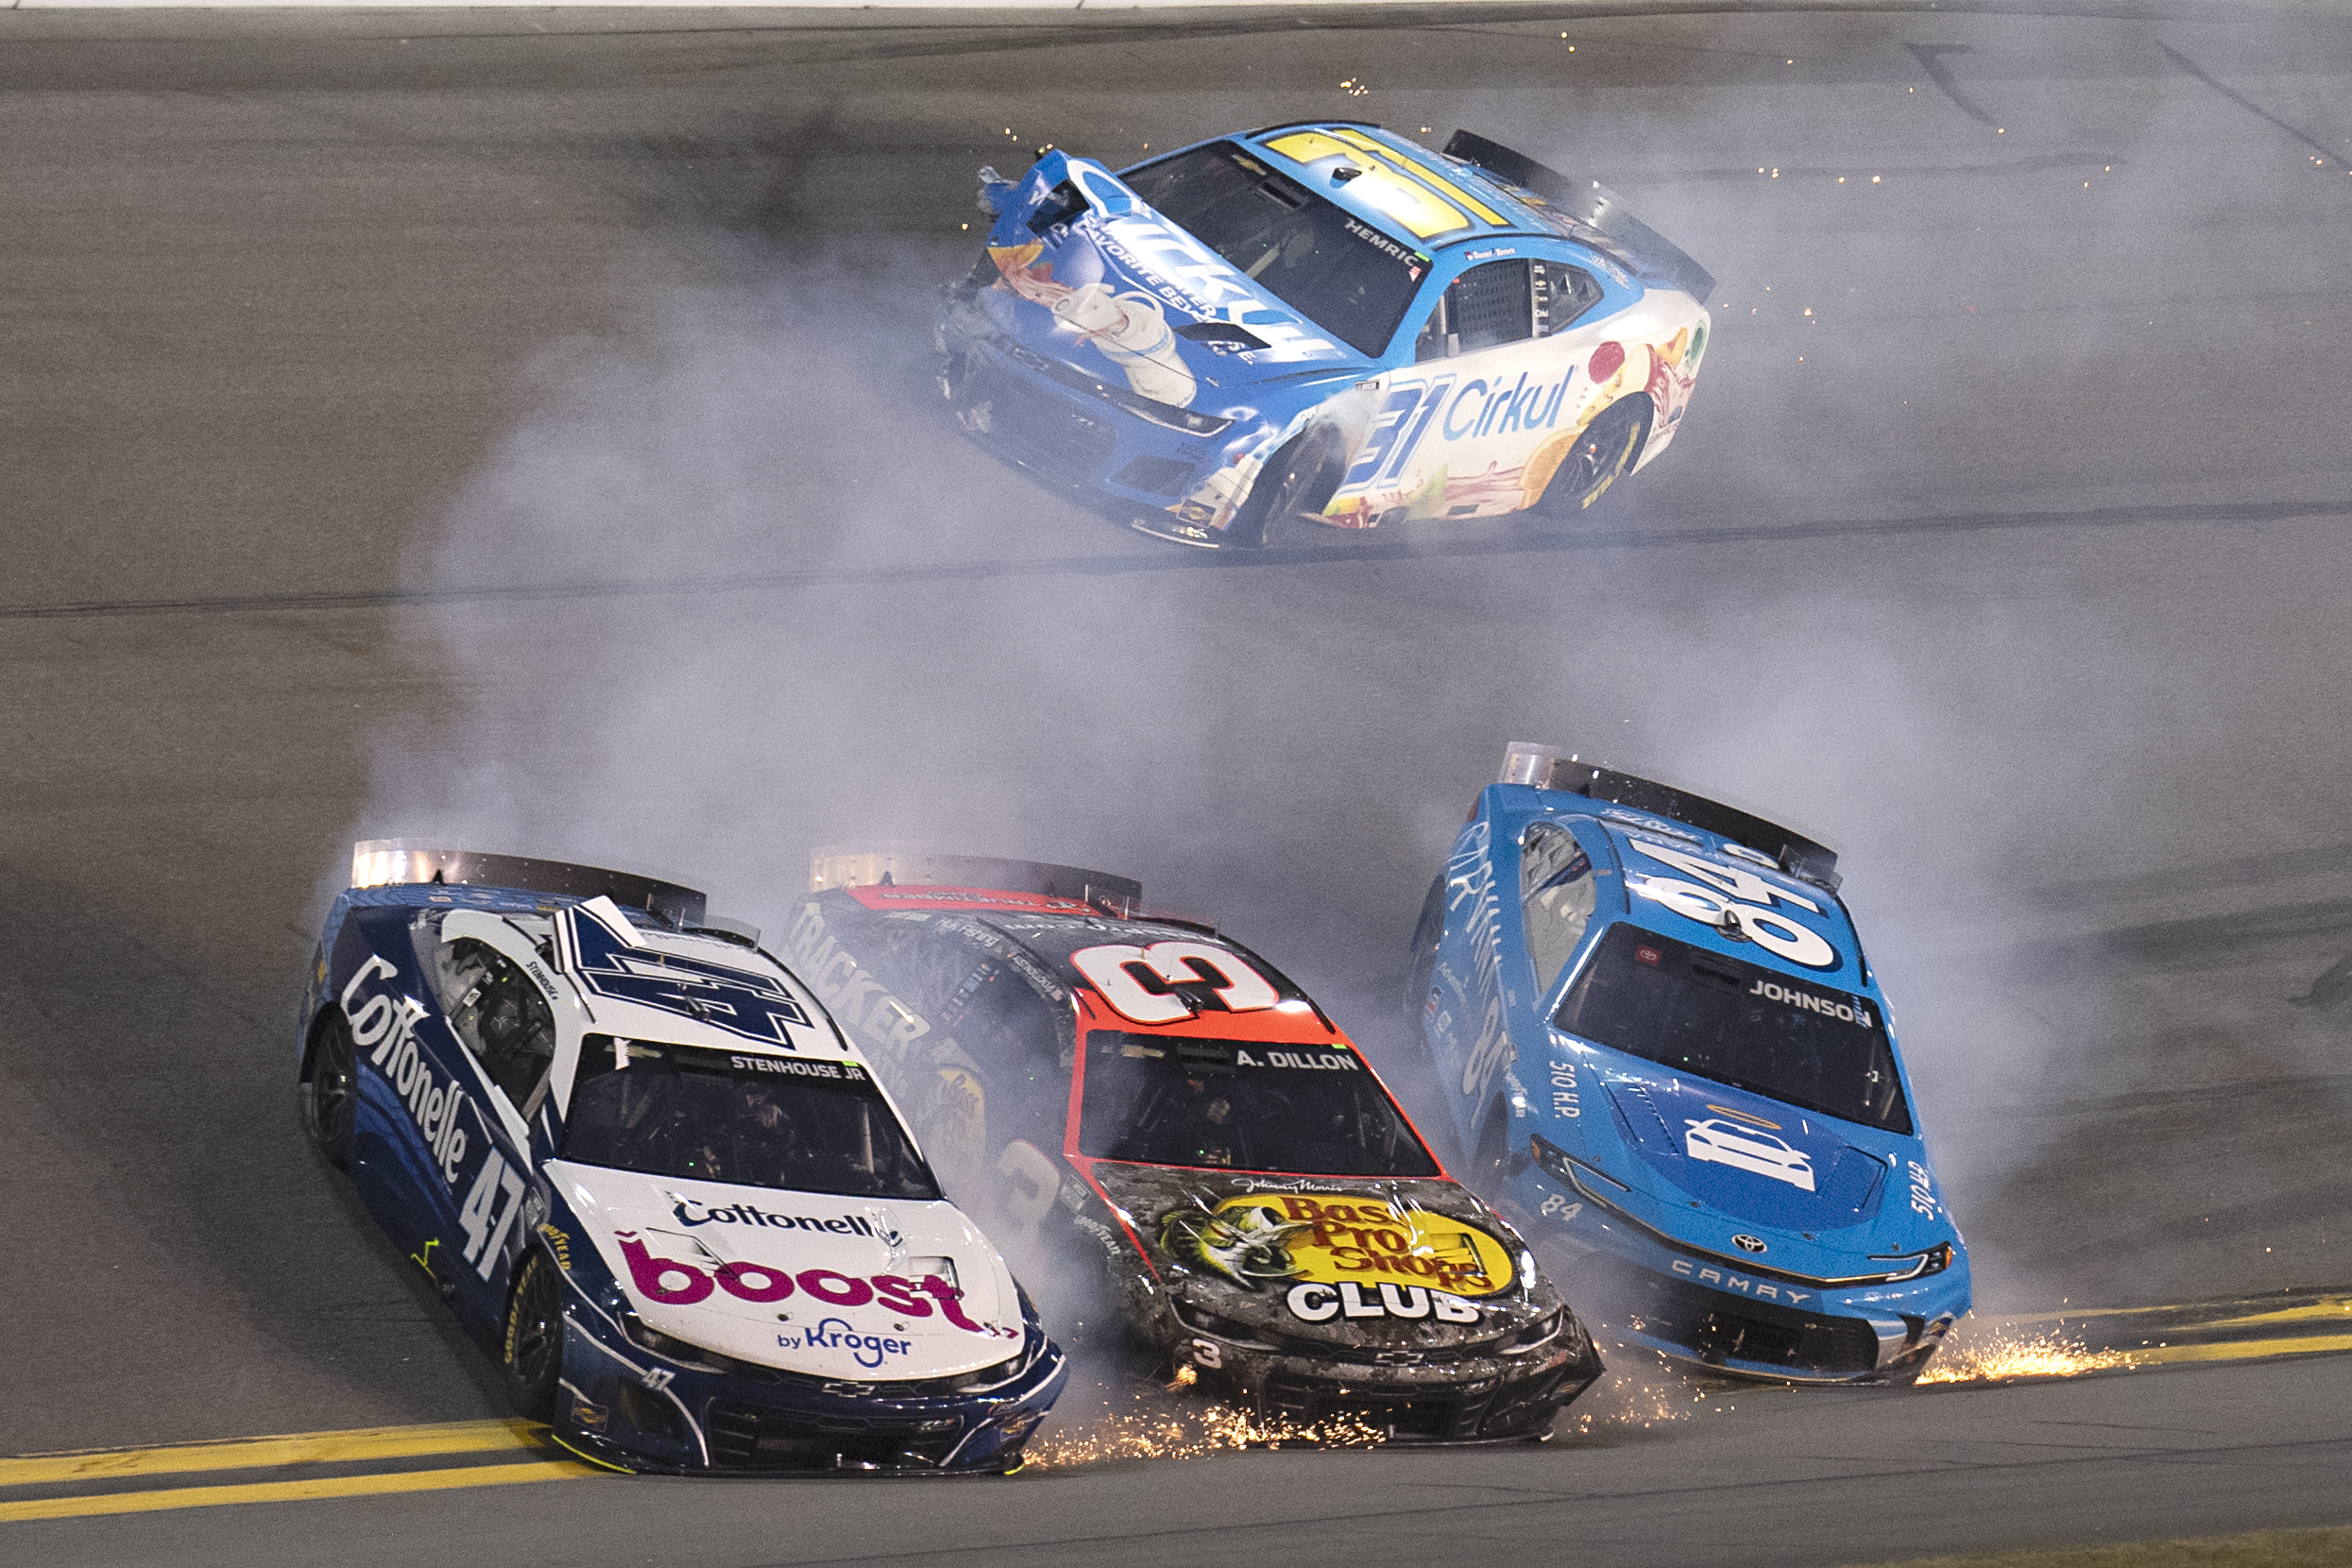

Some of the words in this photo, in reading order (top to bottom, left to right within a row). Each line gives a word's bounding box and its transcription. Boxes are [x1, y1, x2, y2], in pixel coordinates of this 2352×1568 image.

[1344, 216, 1420, 266] HEMRIC
[1442, 365, 1576, 442] Cirkul
[1337, 374, 1457, 497] 31
[1072, 942, 1279, 1024] 3
[1749, 980, 1873, 1028] JOHNSON
[341, 955, 467, 1184] Cottonelle
[731, 1055, 839, 1079] STENHOUSE
[844, 1065, 865, 1081] JR
[1237, 1050, 1264, 1066] A.
[1268, 1051, 1358, 1070] DILLON
[1549, 1060, 1577, 1088] 510
[459, 1146, 527, 1282] 47
[1540, 1193, 1584, 1222] 84
[1311, 1220, 1407, 1254] Pro
[615, 1231, 1020, 1341] boost
[1330, 1246, 1492, 1290] Shops
[1671, 1258, 1812, 1304] CAMRY
[1287, 1281, 1480, 1324] CLUB
[777, 1334, 801, 1349] by
[805, 1318, 912, 1369] Kroger
[1191, 1338, 1222, 1370] 3
